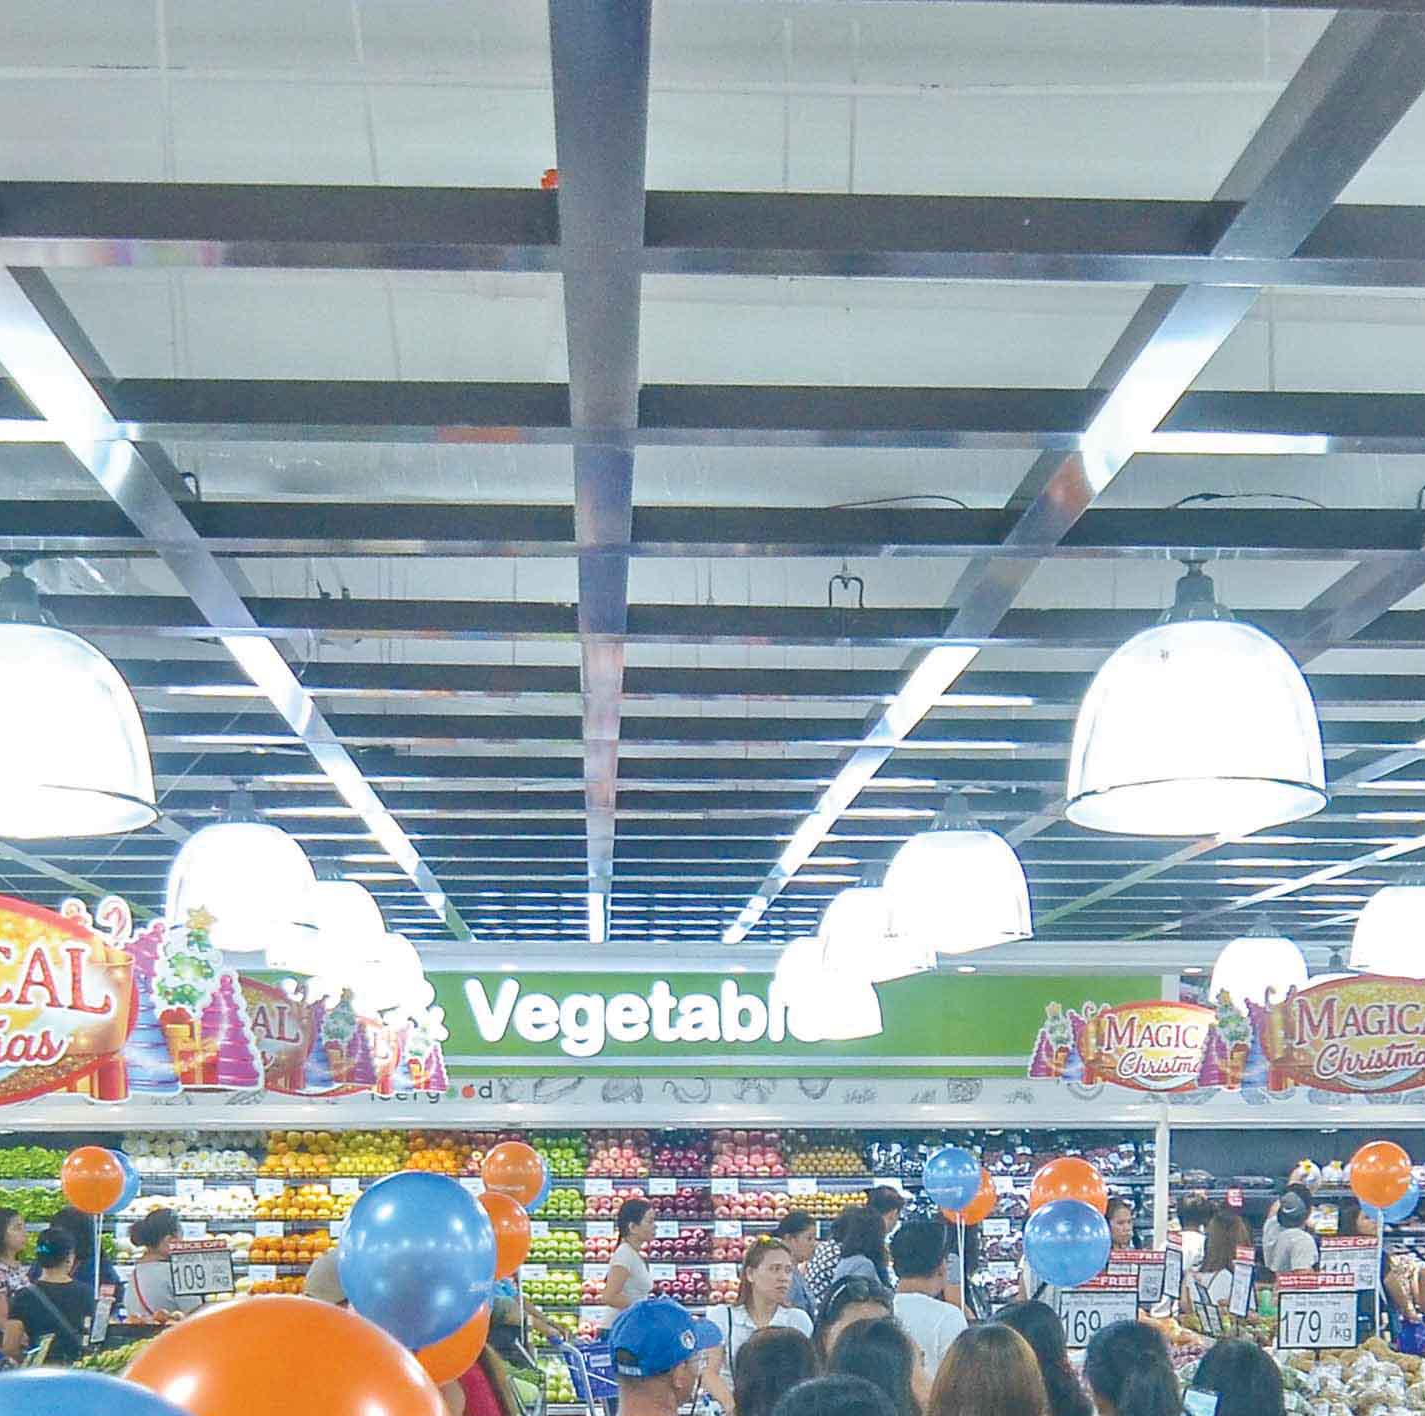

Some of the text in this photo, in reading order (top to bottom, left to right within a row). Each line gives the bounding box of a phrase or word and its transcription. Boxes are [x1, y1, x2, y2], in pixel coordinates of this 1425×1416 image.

[1103, 1016, 1203, 1052] MAGIC
[173, 1264, 206, 1291] 109
[1100, 1276, 1137, 1286] FREE
[1318, 1275, 1354, 1285] FREE
[1280, 1310, 1322, 1344] 179
